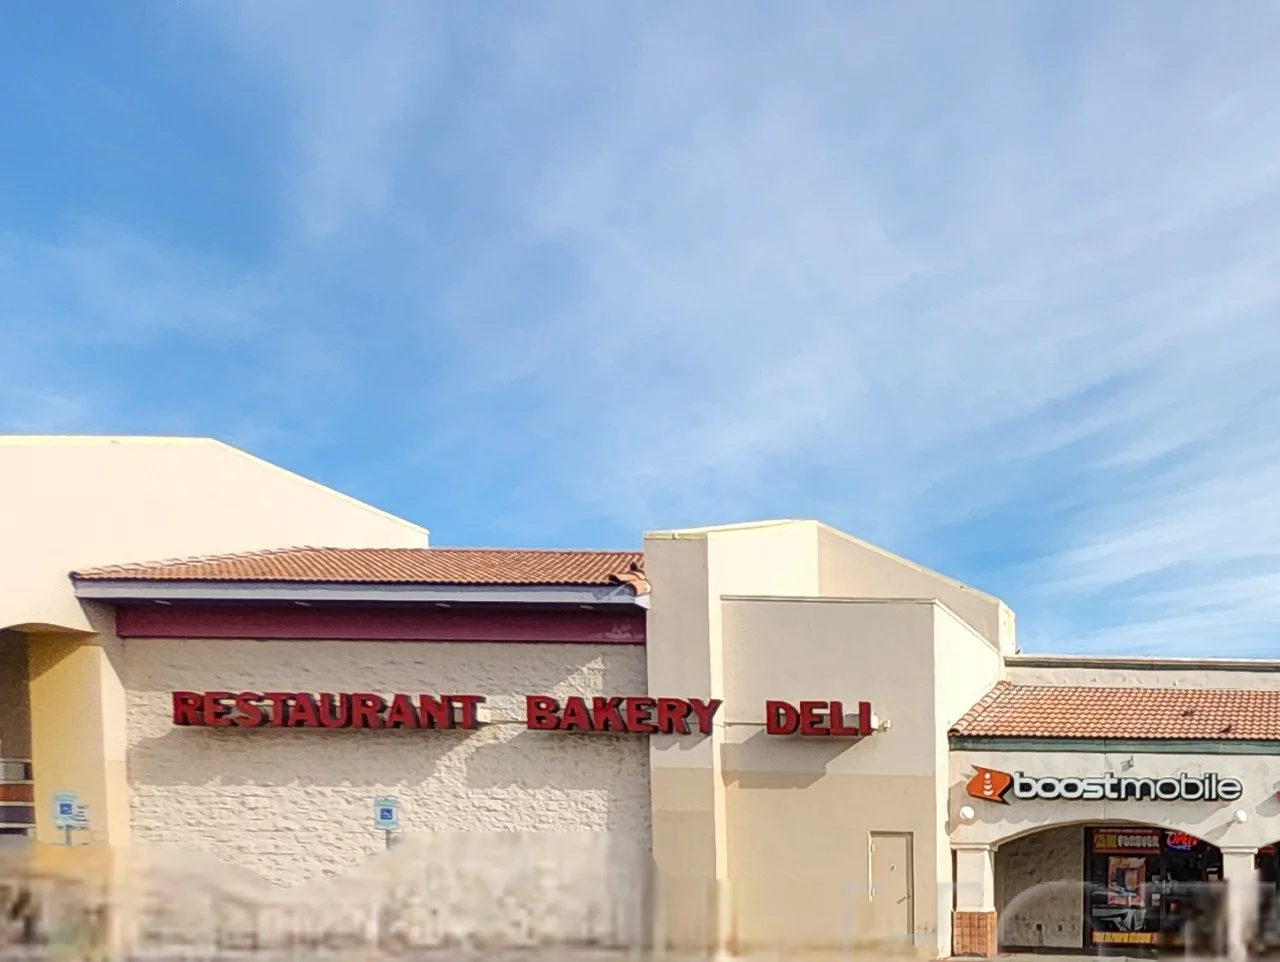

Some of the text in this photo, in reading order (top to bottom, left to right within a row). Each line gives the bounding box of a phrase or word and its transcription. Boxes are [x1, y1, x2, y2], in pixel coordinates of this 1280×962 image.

[173, 691, 871, 737] RESTAURANT BAKERY DELI
